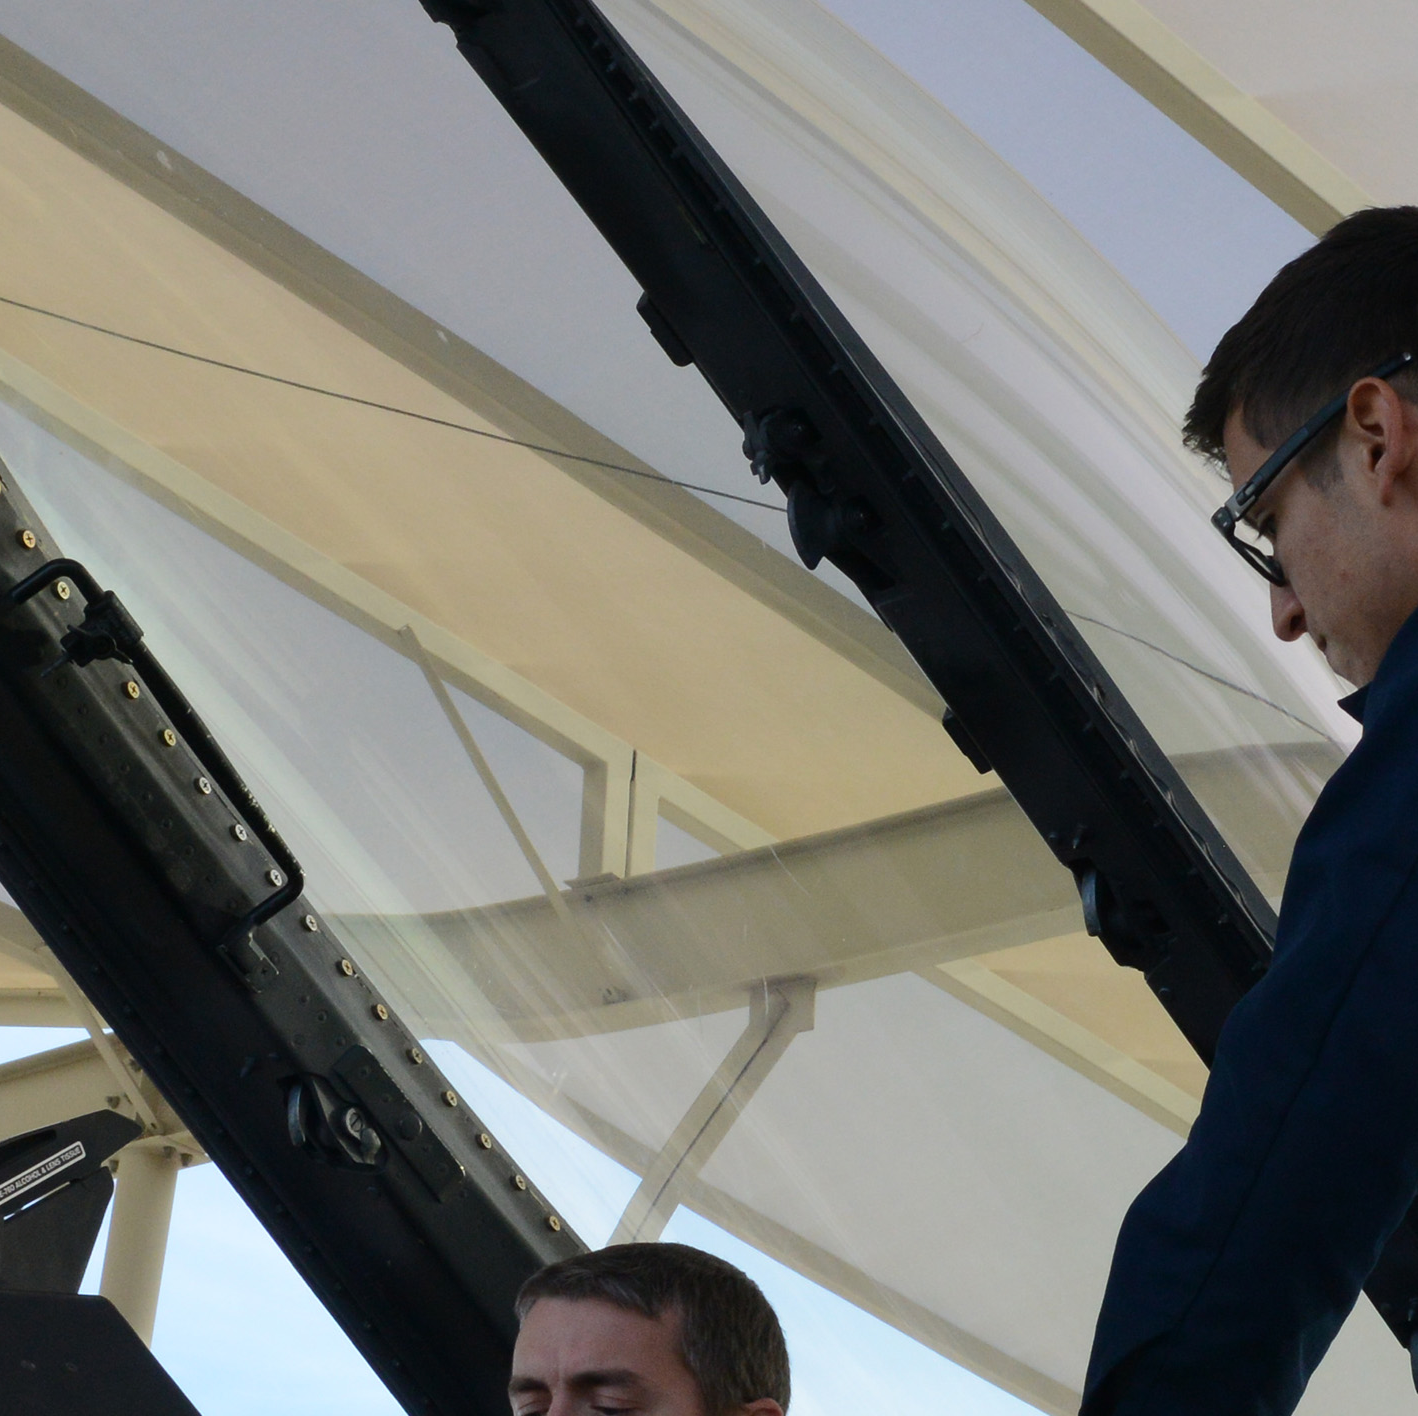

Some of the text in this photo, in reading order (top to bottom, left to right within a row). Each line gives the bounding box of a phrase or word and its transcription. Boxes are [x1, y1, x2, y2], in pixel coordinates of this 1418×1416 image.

[15, 1169, 42, 1189] ALCOHOL
[46, 1158, 61, 1171] LENS
[60, 1146, 81, 1162] TISSUE
